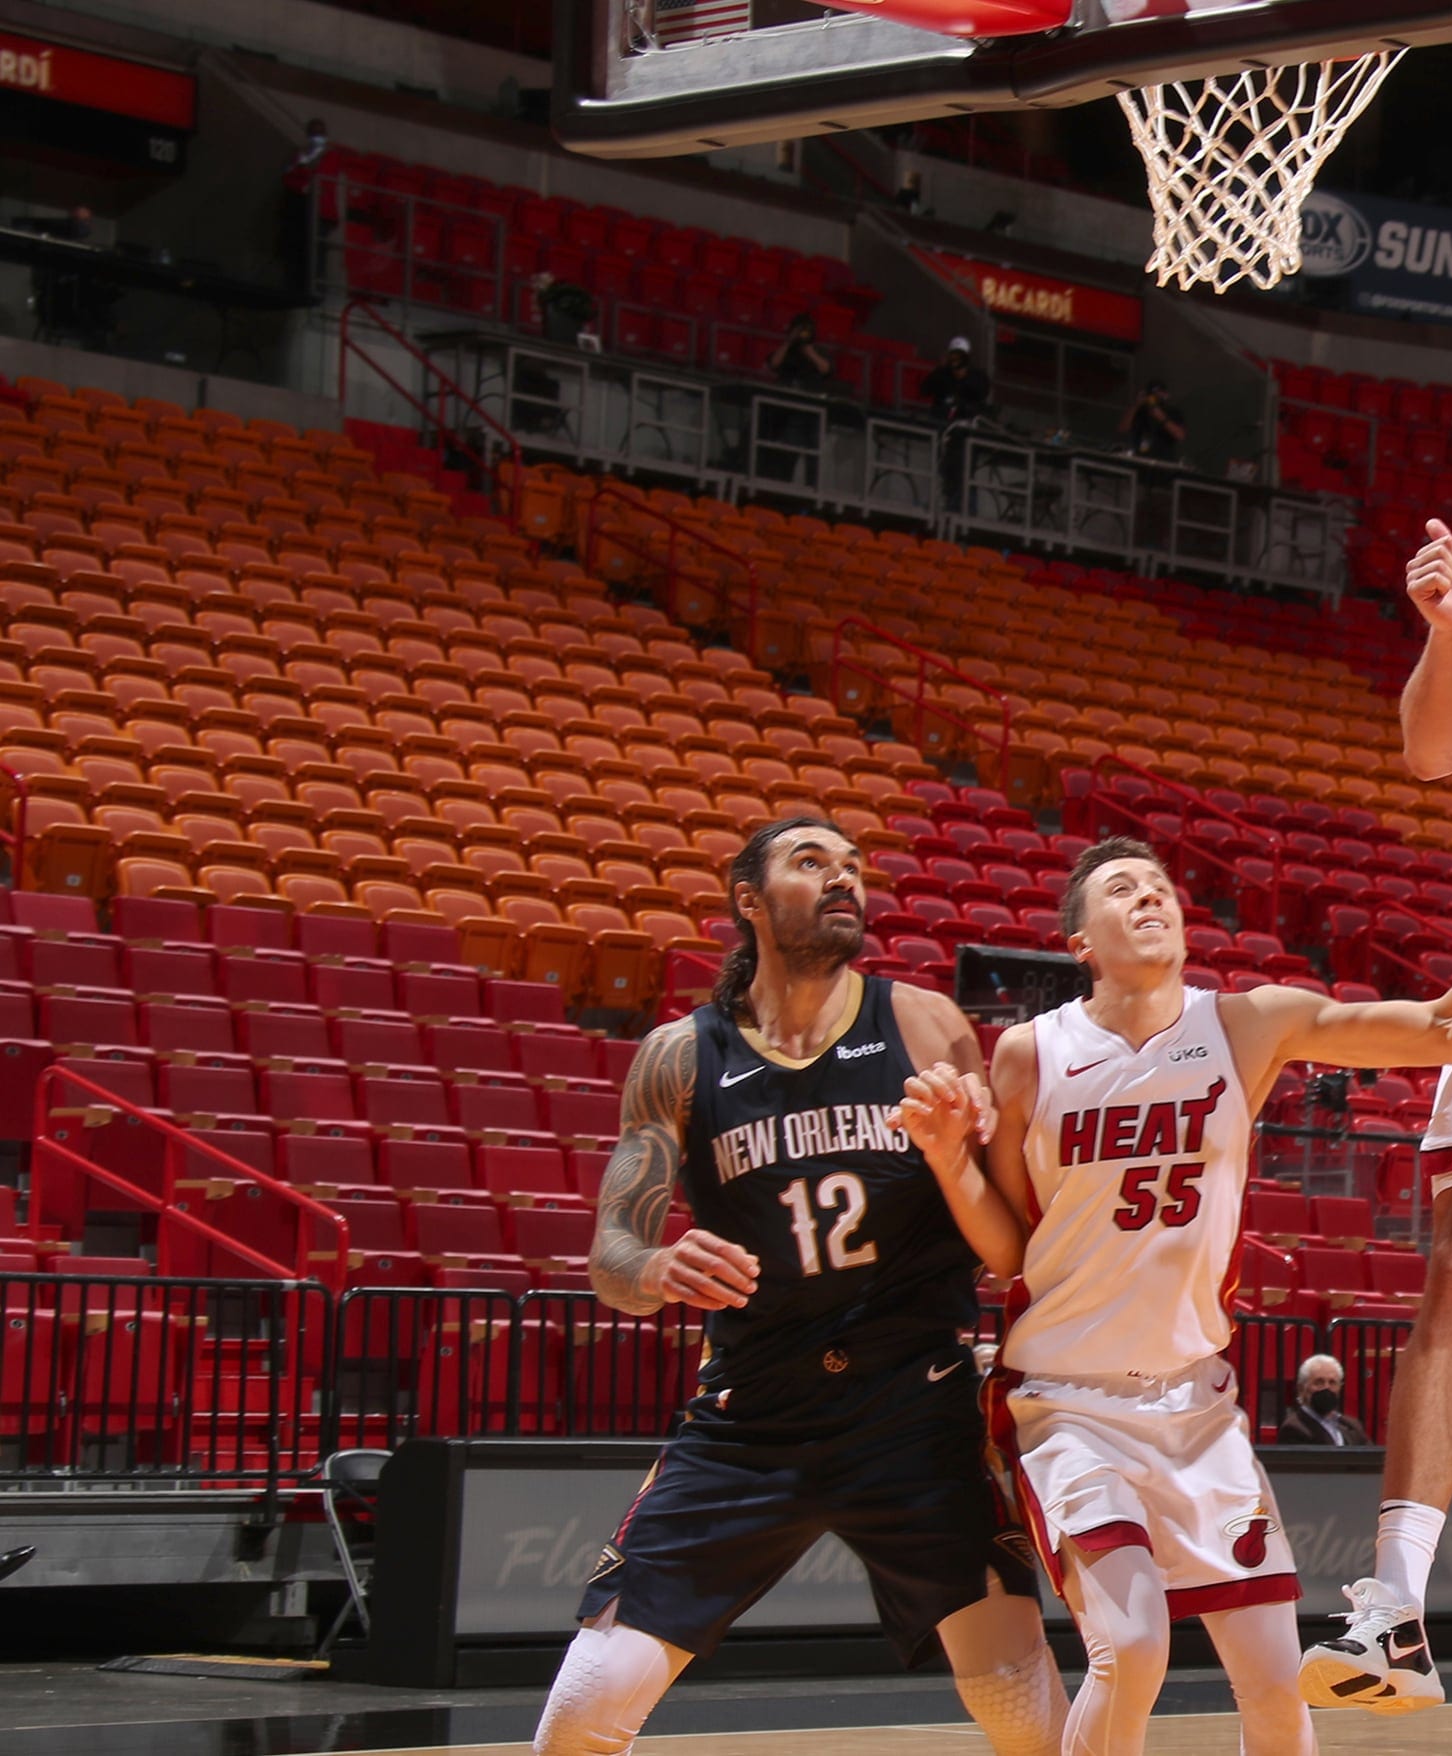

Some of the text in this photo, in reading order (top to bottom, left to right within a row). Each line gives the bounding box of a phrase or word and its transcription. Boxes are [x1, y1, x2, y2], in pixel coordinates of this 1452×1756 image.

[1301, 208, 1344, 247] OX
[981, 276, 1074, 324] BACARDÍ
[836, 1041, 887, 1060] ibotta
[711, 1103, 910, 1186] NEW ORLEANS
[1059, 1075, 1228, 1168] HEAT
[777, 1170, 881, 1278] 12
[1112, 1161, 1206, 1232] 55
